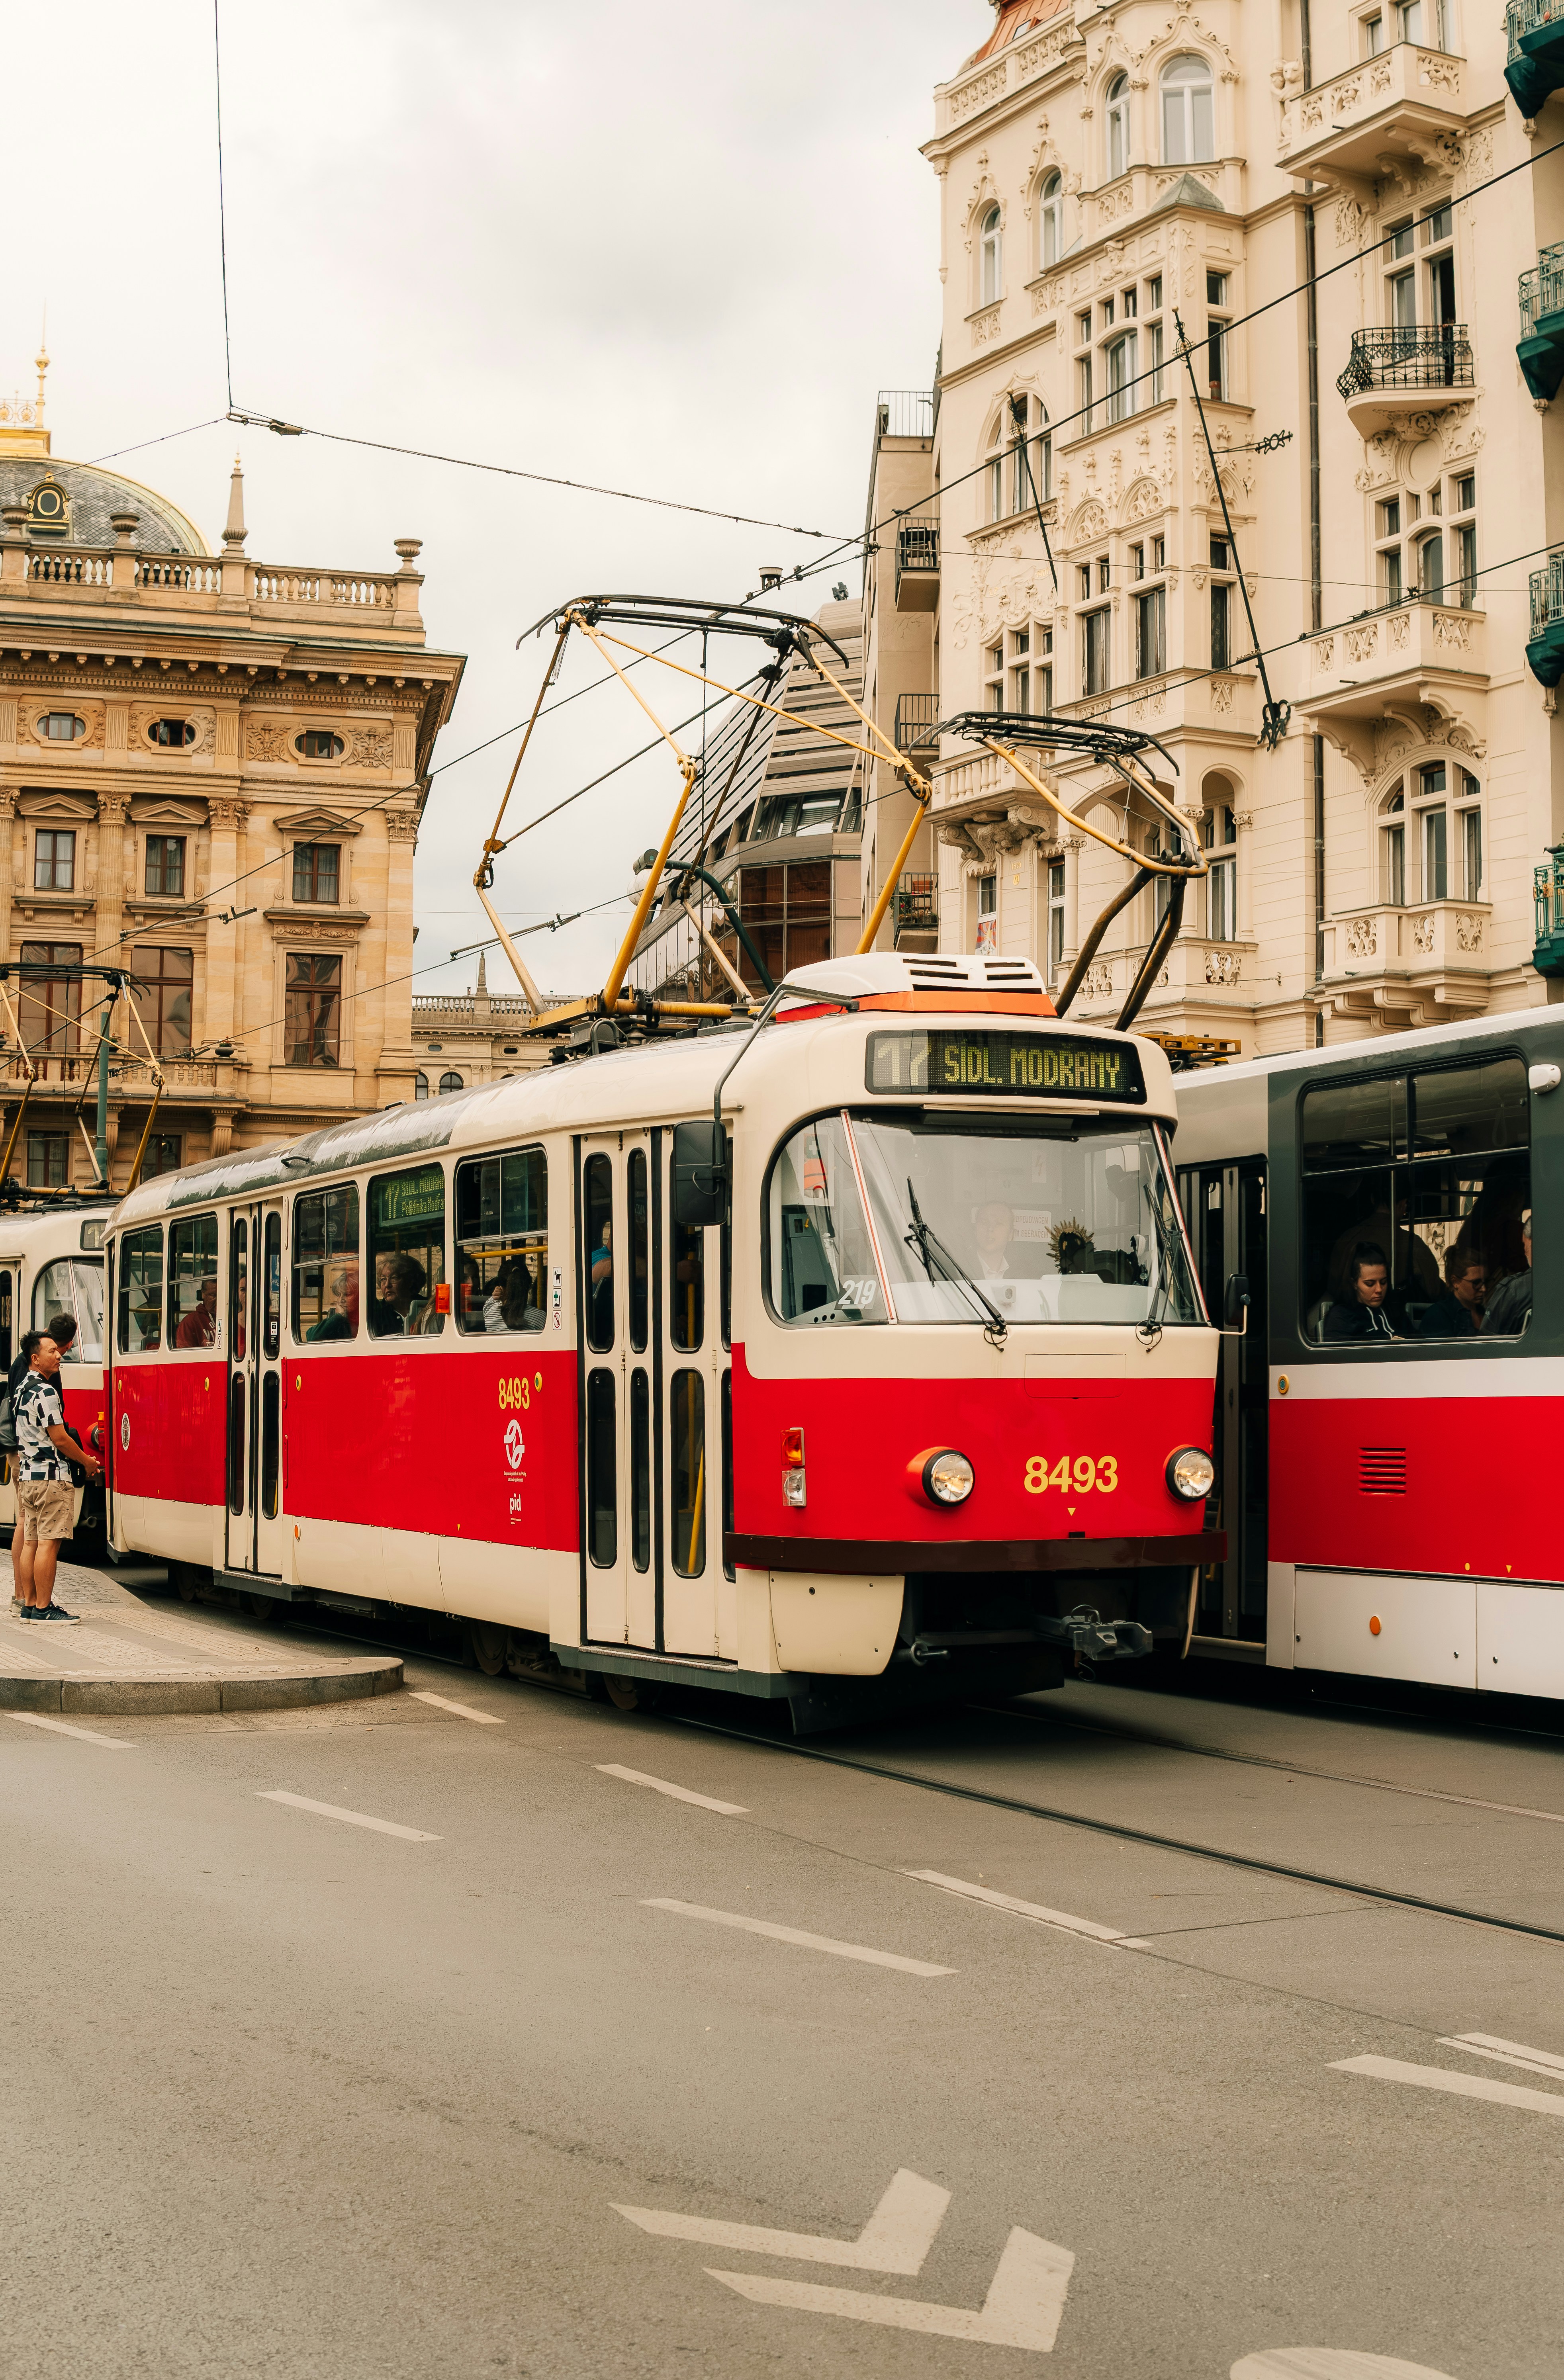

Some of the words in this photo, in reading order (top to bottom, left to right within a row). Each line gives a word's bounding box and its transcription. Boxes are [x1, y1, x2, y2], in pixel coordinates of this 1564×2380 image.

[877, 1038, 932, 1085] 17
[944, 1039, 1003, 1083] SÍDL.
[1010, 1042, 1120, 1088] MODŘANY
[385, 1183, 400, 1218] 17
[838, 1280, 877, 1305] 219
[498, 1377, 530, 1410] 8493
[1024, 1455, 1118, 1493] 8493
[509, 1492, 521, 1514] pid
